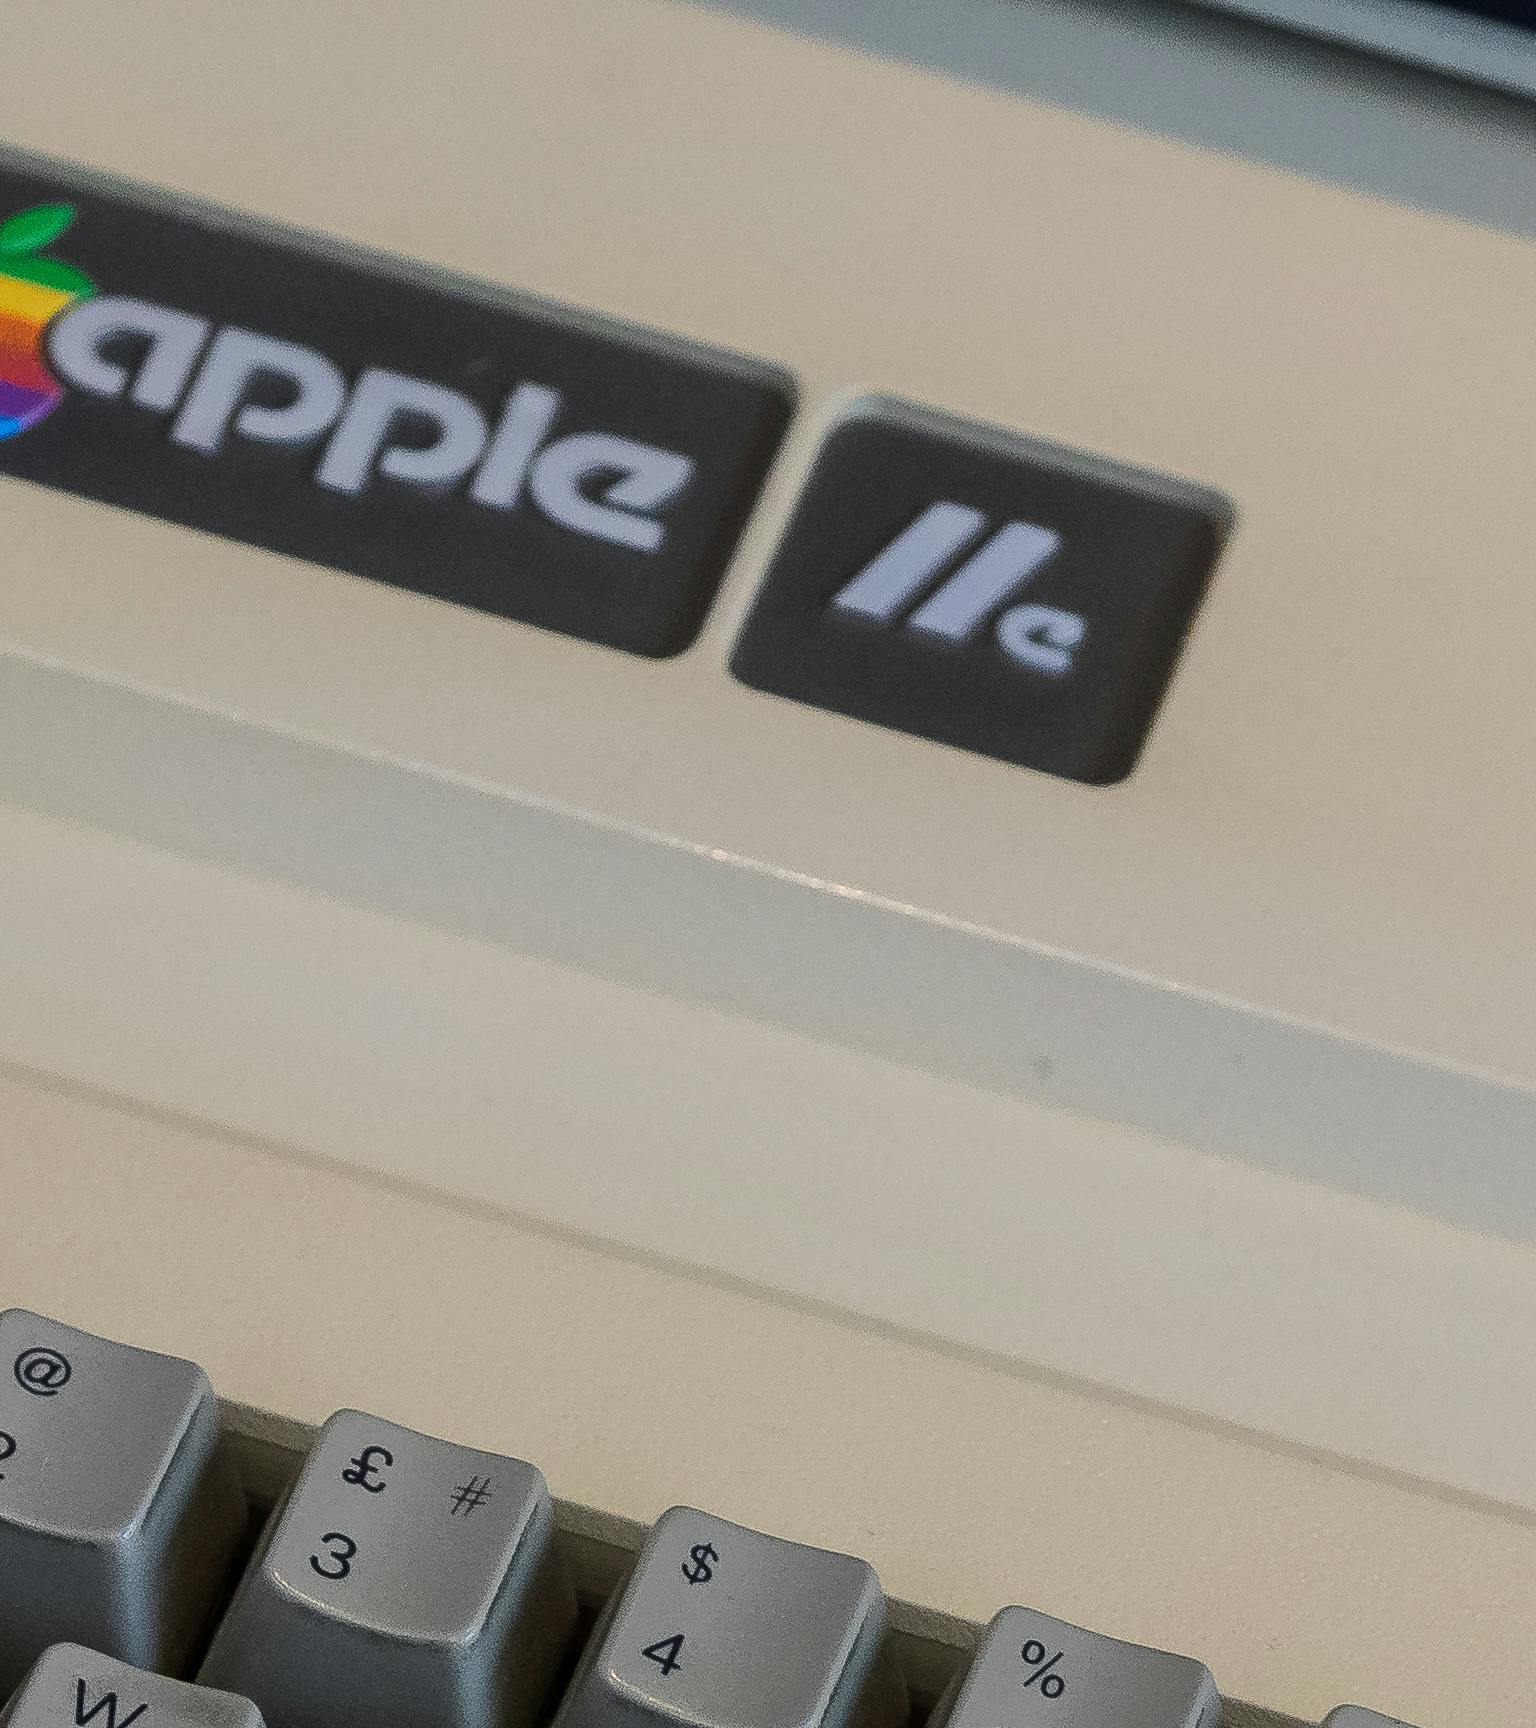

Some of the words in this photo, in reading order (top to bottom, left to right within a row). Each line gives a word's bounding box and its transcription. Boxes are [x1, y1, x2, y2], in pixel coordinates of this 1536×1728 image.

[47, 294, 695, 554] apple
[12, 1346, 74, 1398] @
[341, 1445, 395, 1495] £
[450, 1475, 492, 1516] #
[308, 1531, 359, 1582] 3
[680, 1542, 720, 1586] $
[641, 1633, 686, 1677] 4
[1020, 1638, 1067, 1700] %
